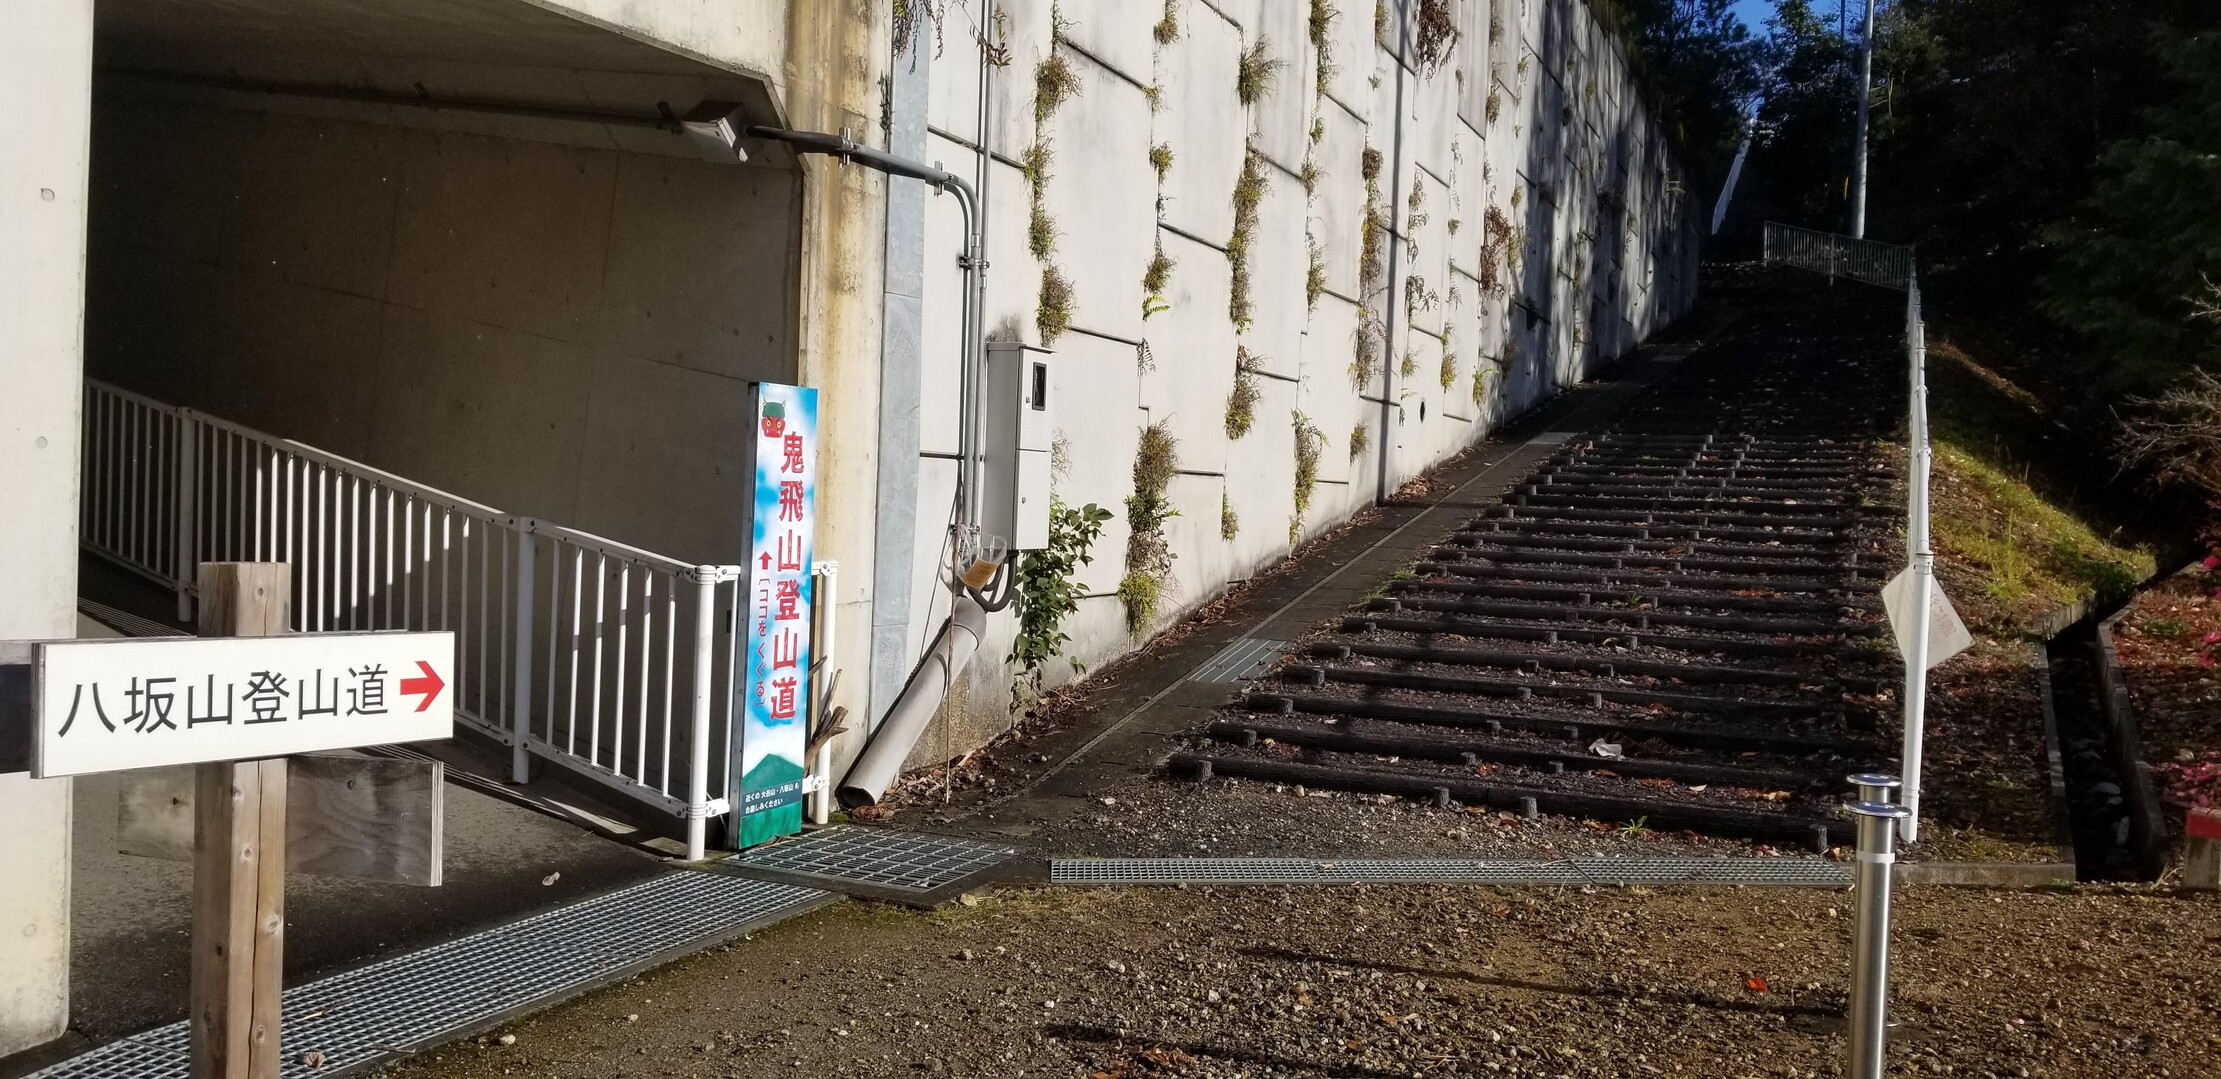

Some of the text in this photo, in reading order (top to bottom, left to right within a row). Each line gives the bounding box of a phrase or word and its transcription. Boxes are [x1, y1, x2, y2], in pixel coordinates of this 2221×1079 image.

[768, 431, 804, 719] 鬼飛山登山道
[58, 663, 389, 737] 八坂山登山道
